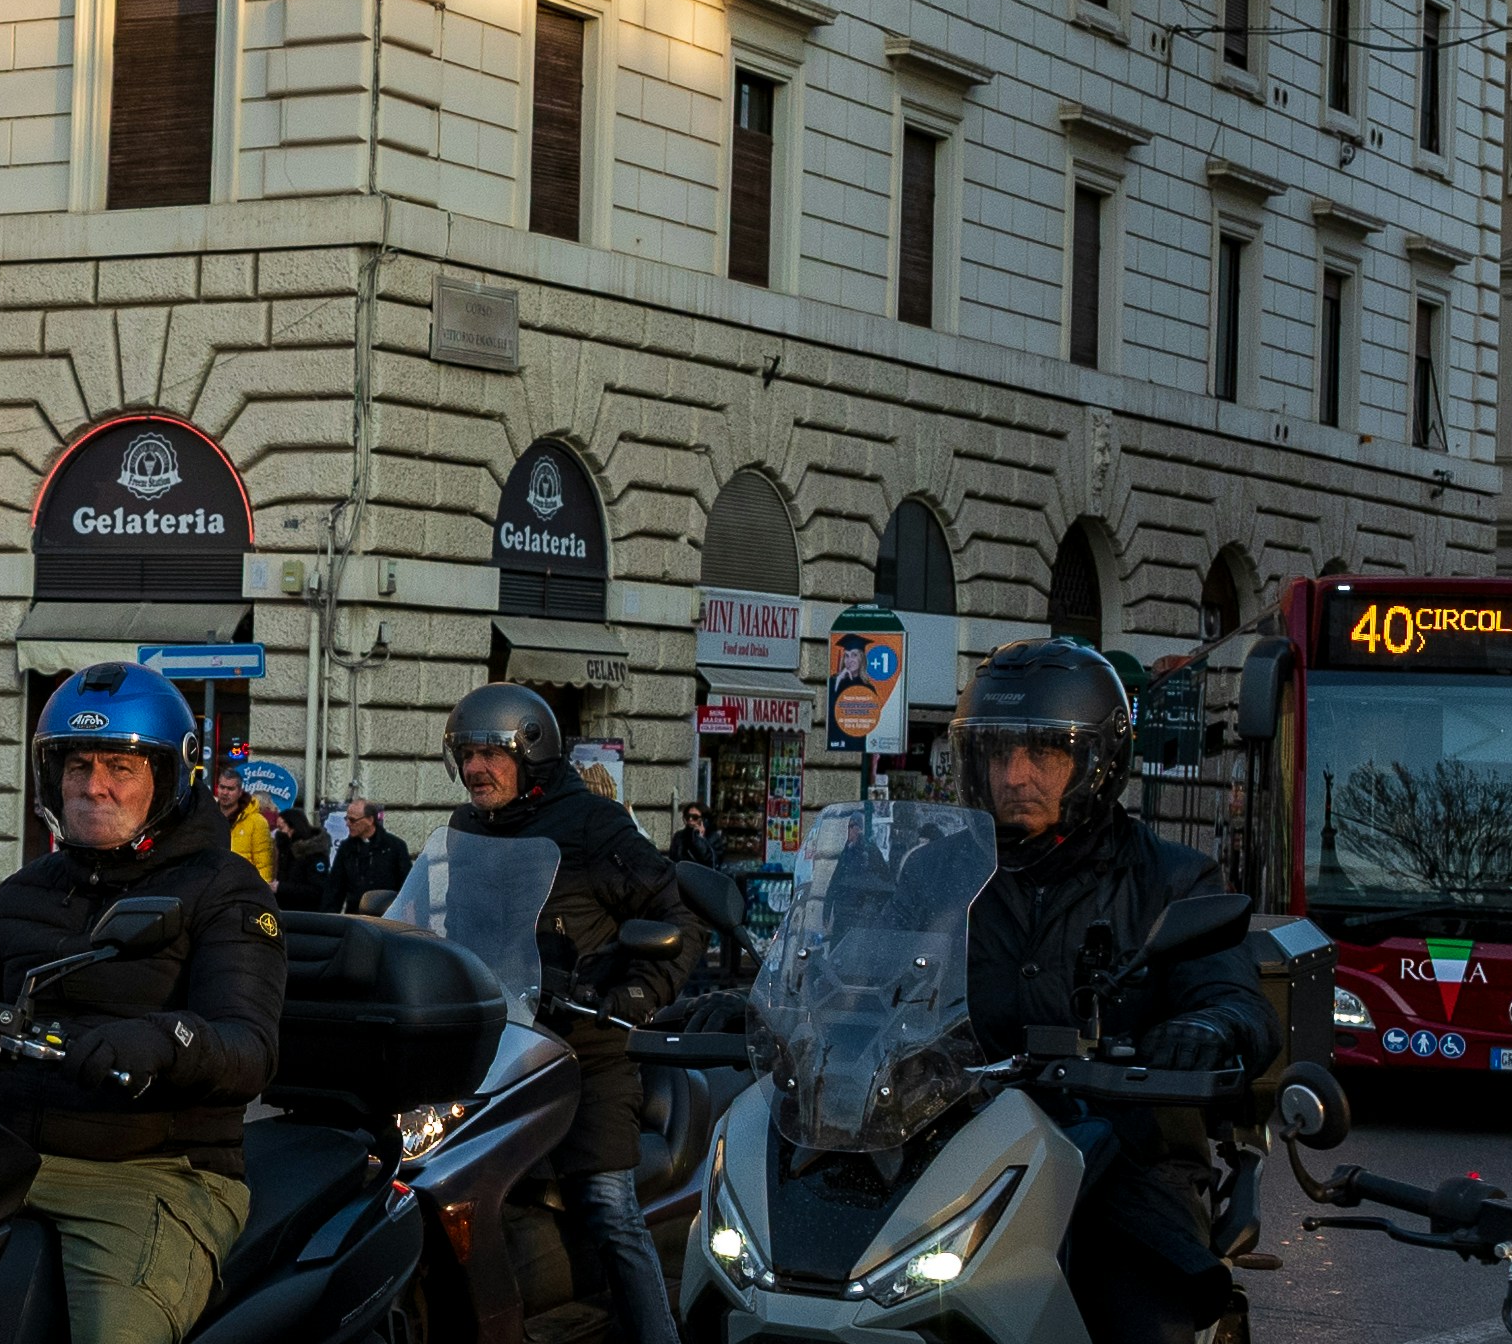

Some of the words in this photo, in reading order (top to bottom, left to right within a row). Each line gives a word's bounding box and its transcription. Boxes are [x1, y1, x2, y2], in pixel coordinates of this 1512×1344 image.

[72, 506, 225, 535] Gelateria
[500, 522, 587, 558] Gelateria
[738, 603, 800, 639] MARKET
[1350, 604, 1414, 654] 40
[870, 652, 890, 673] +1
[983, 692, 1026, 701] NOLAN
[71, 713, 105, 725] Airoh
[753, 699, 801, 724] MARKET
